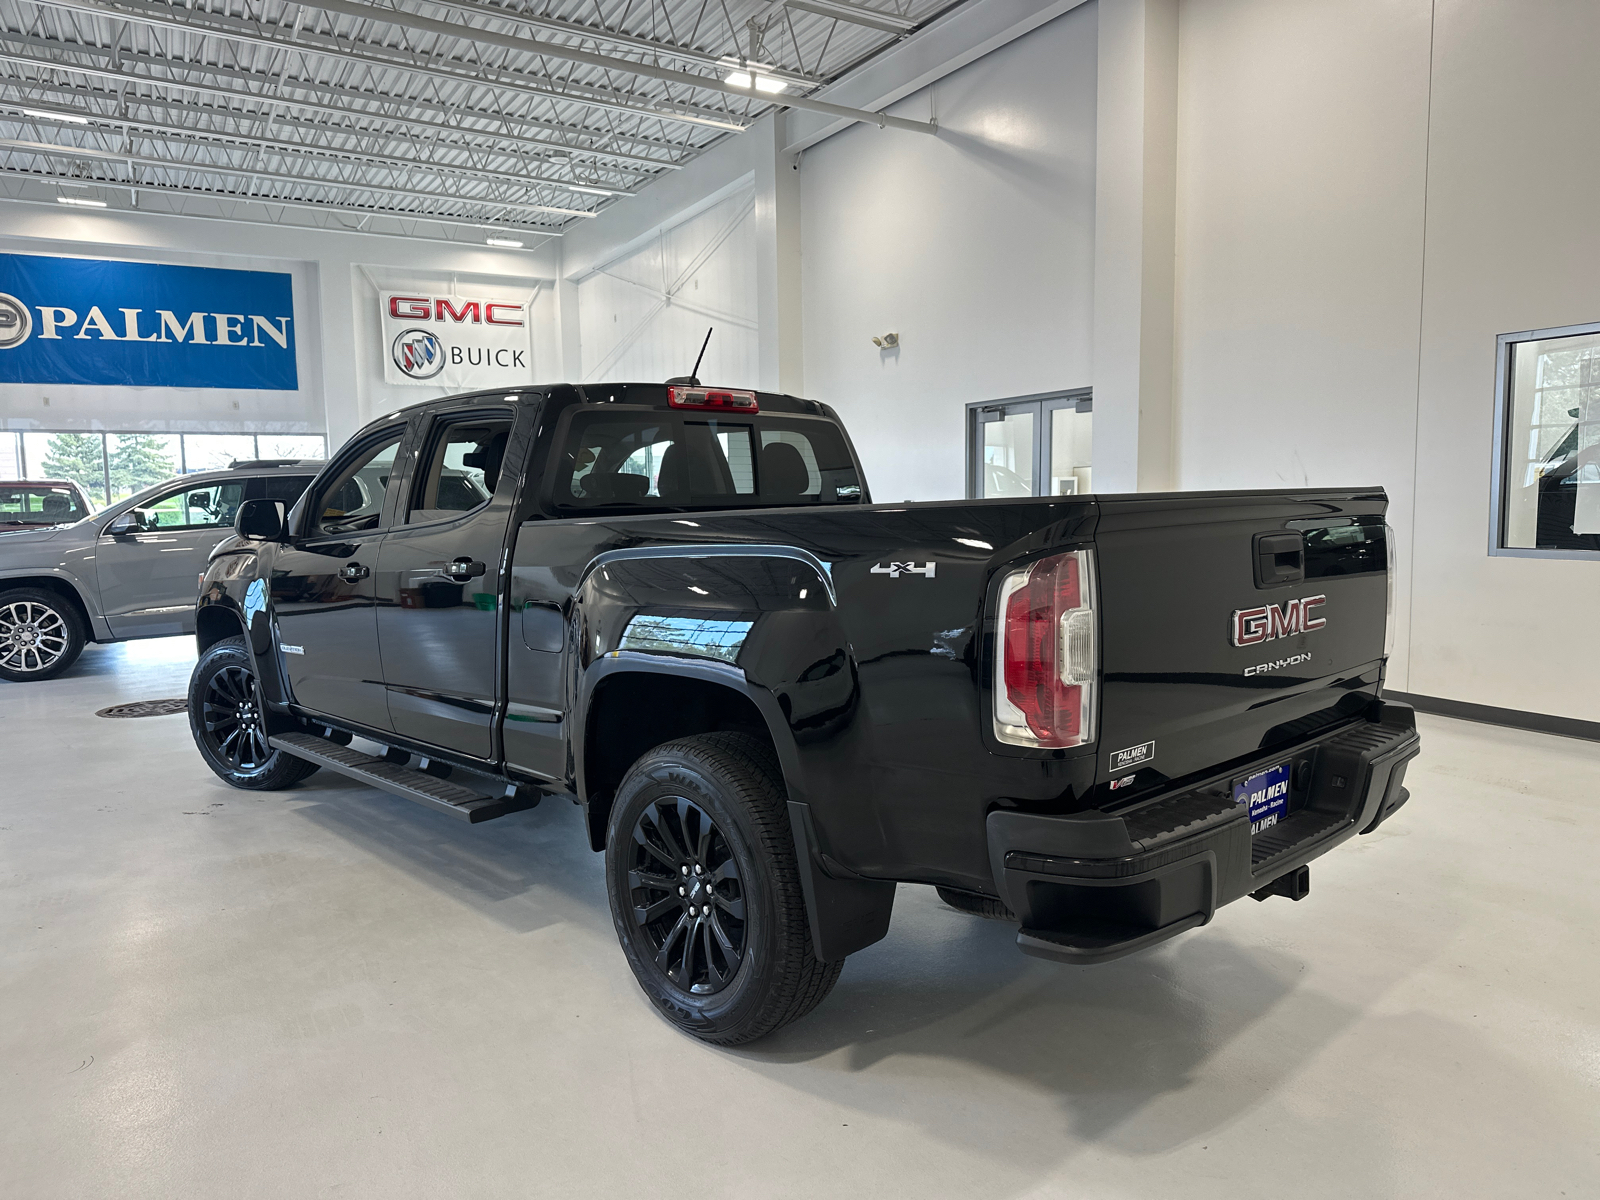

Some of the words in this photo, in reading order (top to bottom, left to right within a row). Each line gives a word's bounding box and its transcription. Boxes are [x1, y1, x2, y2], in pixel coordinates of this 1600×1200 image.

[388, 295, 524, 327] GMC
[35, 305, 291, 350] PALMEN
[451, 346, 526, 368] BUICK
[1231, 594, 1327, 647] GMC
[1243, 652, 1312, 677] CANYON
[1117, 745, 1147, 762] PALMEN
[1250, 780, 1288, 807] PALMEN
[1251, 813, 1278, 835] ALMEN
